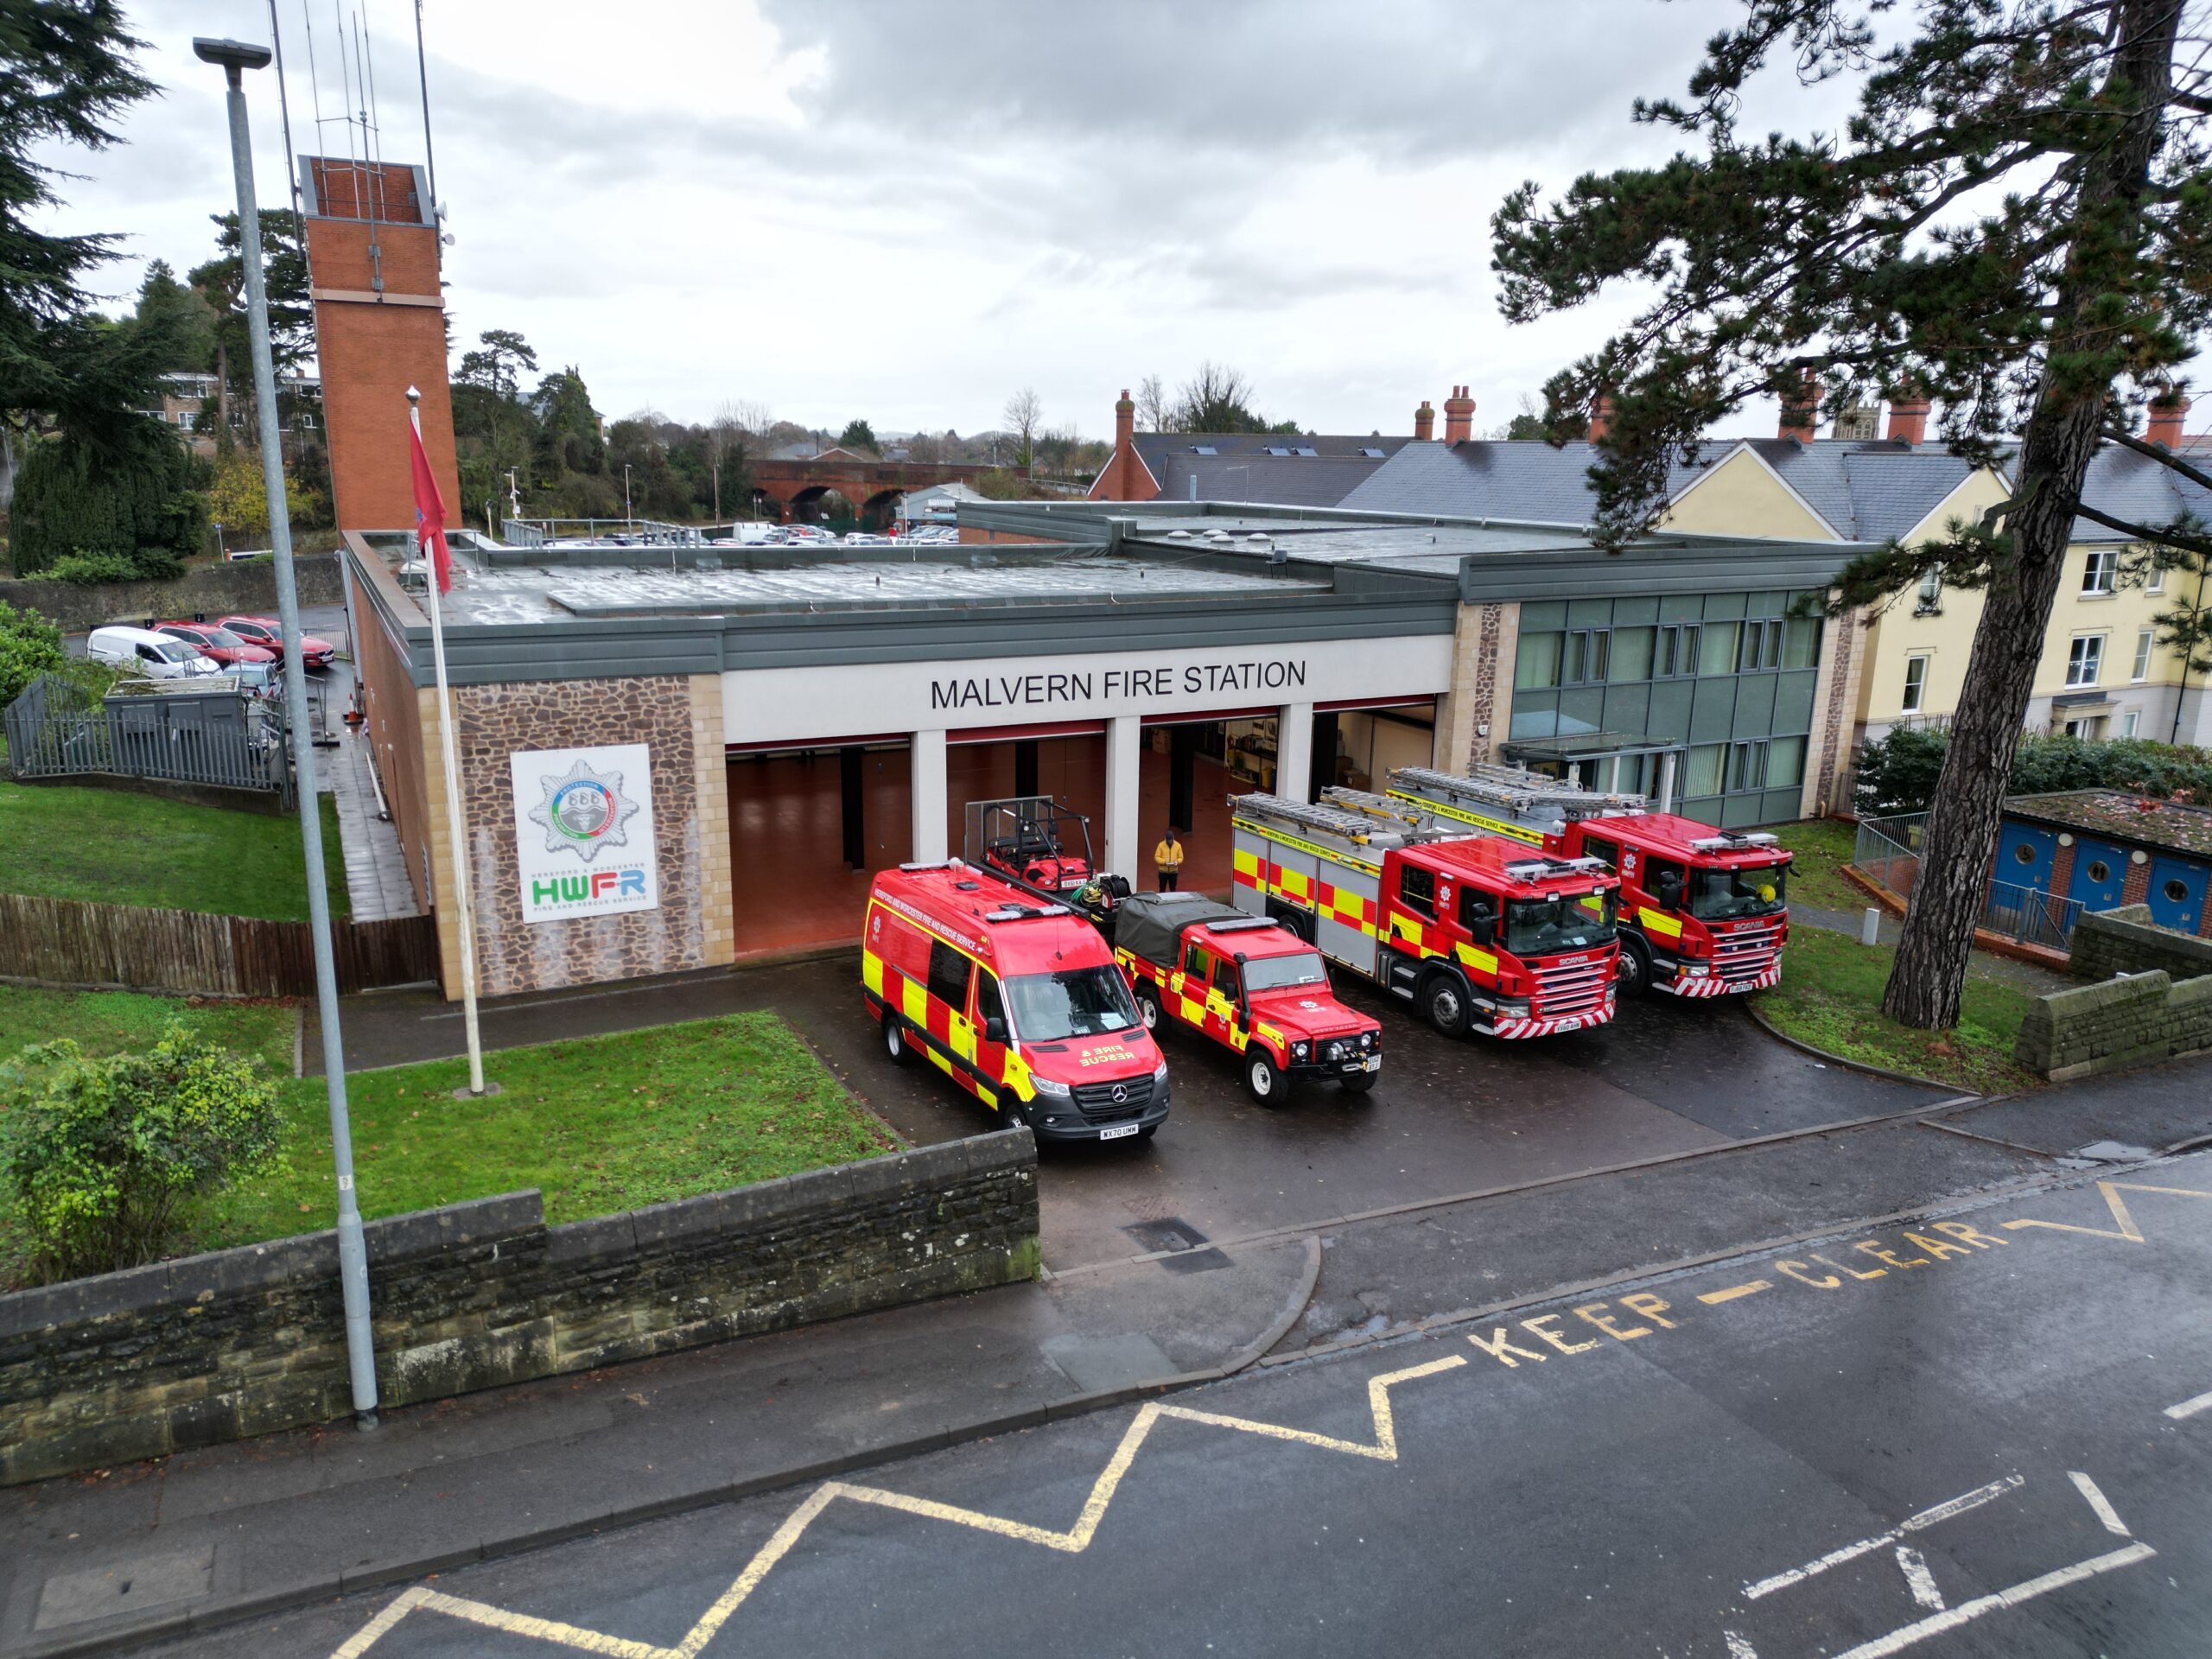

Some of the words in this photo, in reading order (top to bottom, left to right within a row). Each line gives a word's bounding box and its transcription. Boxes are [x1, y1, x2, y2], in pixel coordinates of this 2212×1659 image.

[931, 672, 1092, 709] MALVERN
[1103, 668, 1173, 699] FIRE
[1183, 660, 1306, 693] STATION
[1473, 816, 1484, 824] RESCUE
[1486, 819, 1498, 828] SERVICE
[531, 869, 578, 878] HEREFORD
[593, 863, 645, 872] WORCESTER
[899, 901, 923, 921] WORCESTER
[922, 914, 932, 926] FIRE
[931, 920, 941, 931] AND
[940, 924, 958, 941] RESCUE
[957, 933, 976, 950] SERVICE
[1734, 920, 1764, 931] SCANIA
[1559, 956, 1588, 965] SCANIA
[1103, 1128, 1122, 1138] WX70
[1467, 1293, 1678, 1368] KEEP
[1775, 1220, 2010, 1287] CLEAR
